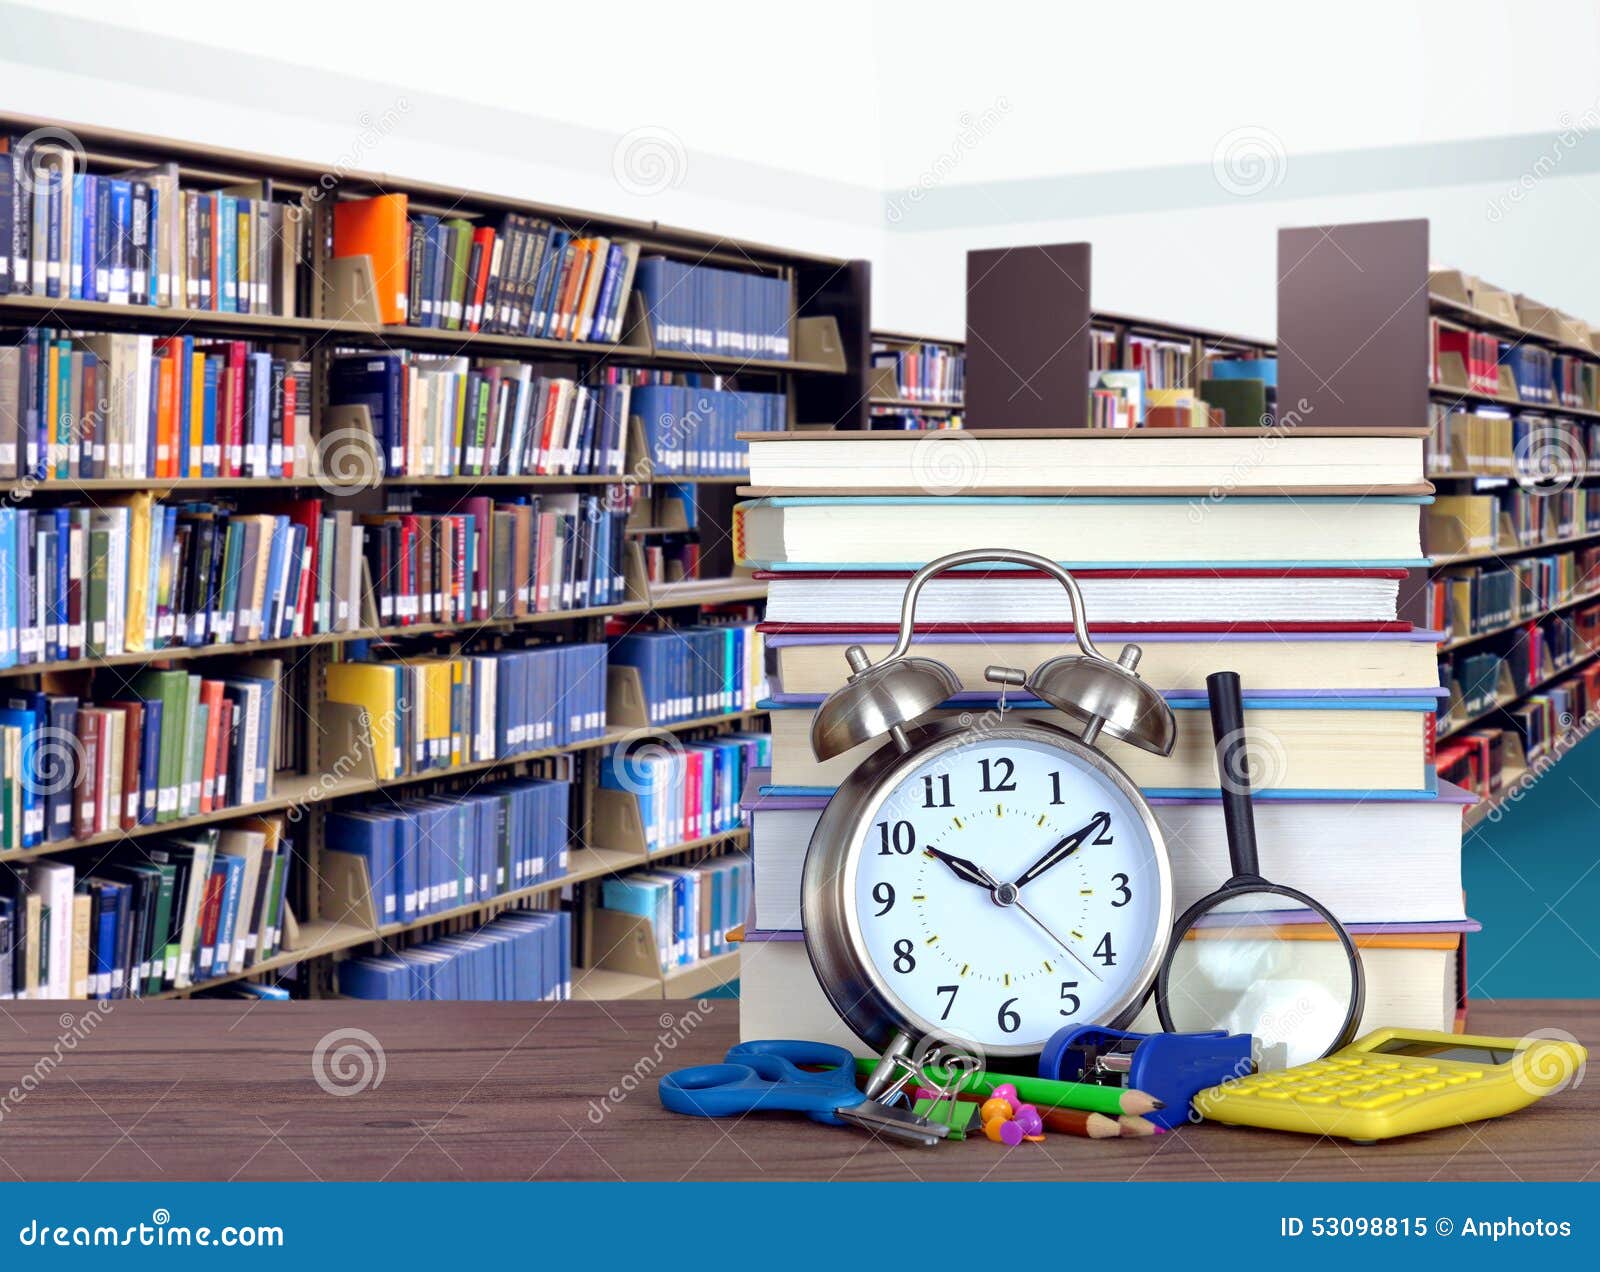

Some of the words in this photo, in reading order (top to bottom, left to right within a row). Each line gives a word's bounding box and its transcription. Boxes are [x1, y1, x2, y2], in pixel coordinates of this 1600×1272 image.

[920, 774, 955, 808] 11
[978, 757, 1017, 792] 12
[1048, 771, 1065, 805] 1
[876, 820, 916, 856] 10
[1091, 811, 1114, 846] 2
[872, 882, 896, 917] 9
[1111, 872, 1132, 908] 3
[893, 938, 916, 974] 8
[1092, 932, 1117, 966] 4
[936, 985, 959, 1021] 7
[997, 997, 1021, 1033] 6
[1059, 981, 1081, 1016] 5
